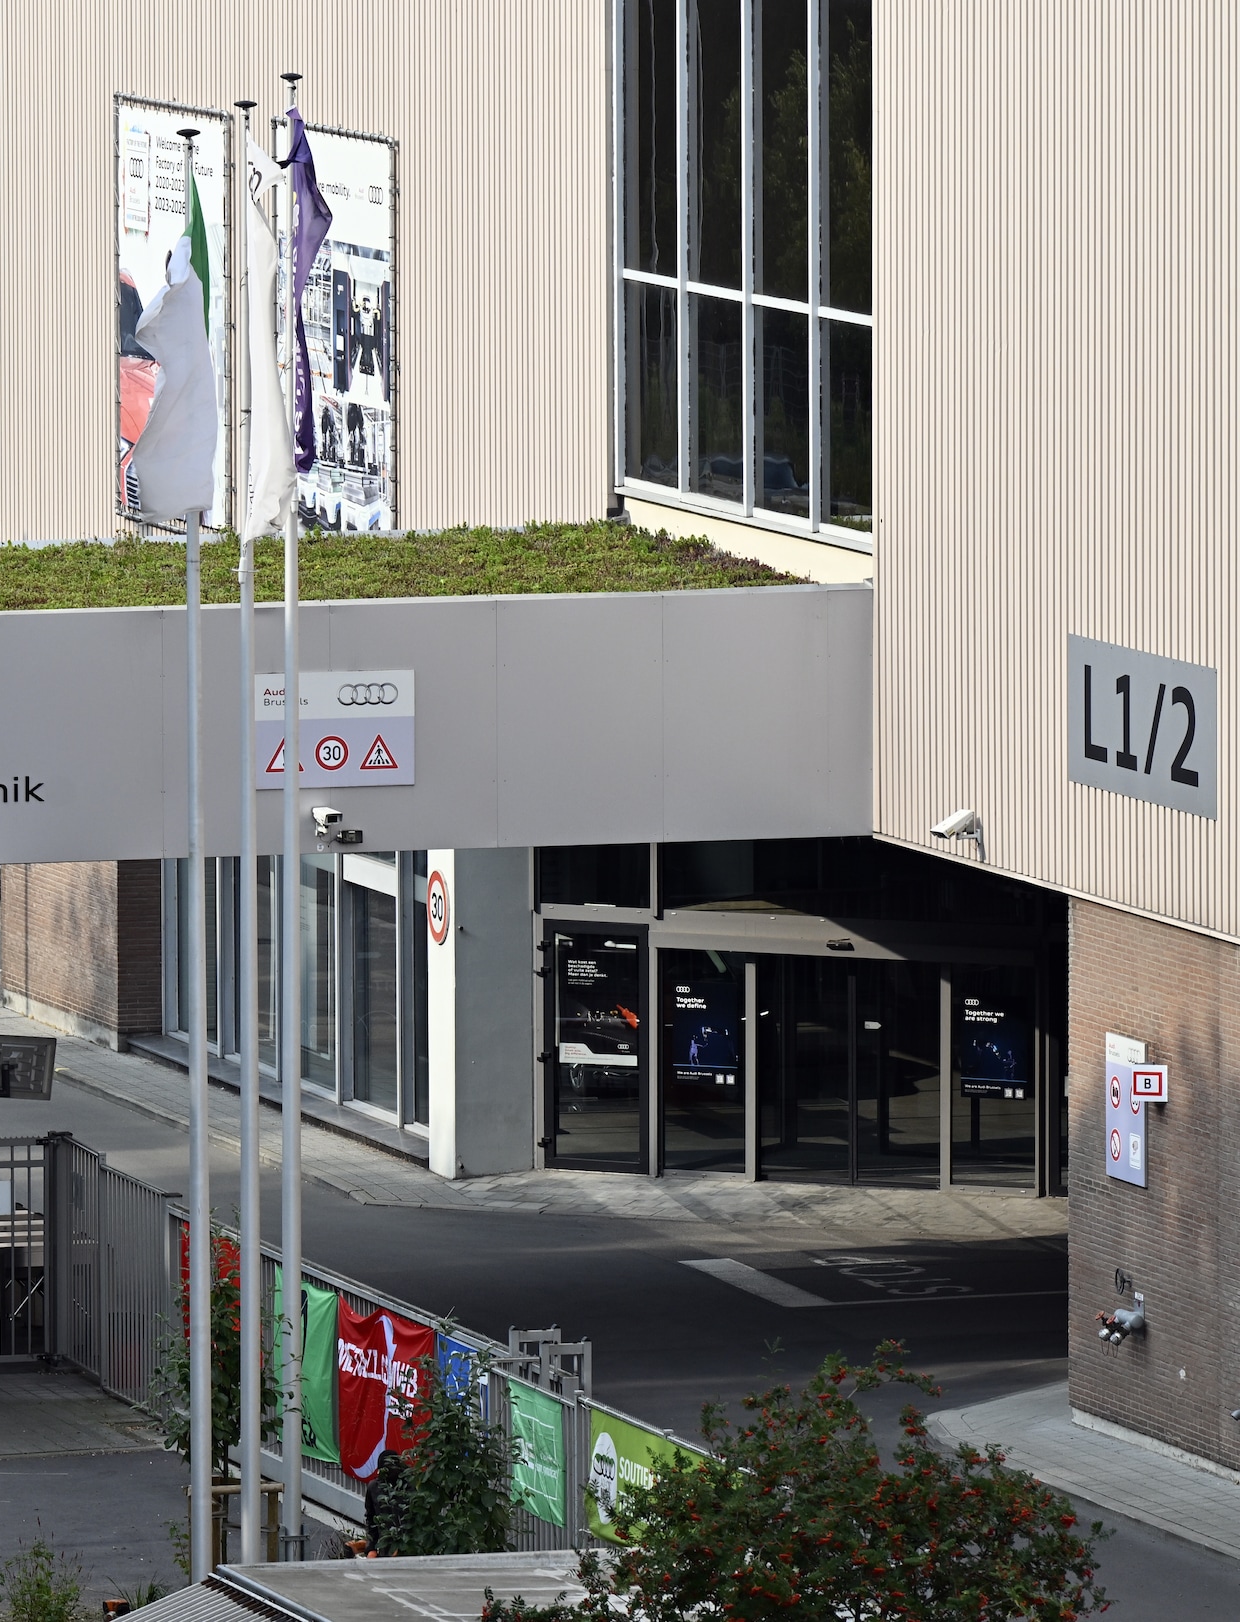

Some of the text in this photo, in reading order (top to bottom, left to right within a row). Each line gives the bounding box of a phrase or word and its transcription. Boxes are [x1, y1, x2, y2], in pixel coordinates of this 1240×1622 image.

[155, 135, 181, 152] Welcome
[155, 155, 214, 178] Factory of Future
[155, 175, 185, 193] 2020-2023
[1084, 664, 1199, 788] L1/2
[322, 746, 341, 761] 30
[432, 892, 443, 922] 30
[964, 1009, 993, 1018] Together
[1144, 1078, 1152, 1090] B
